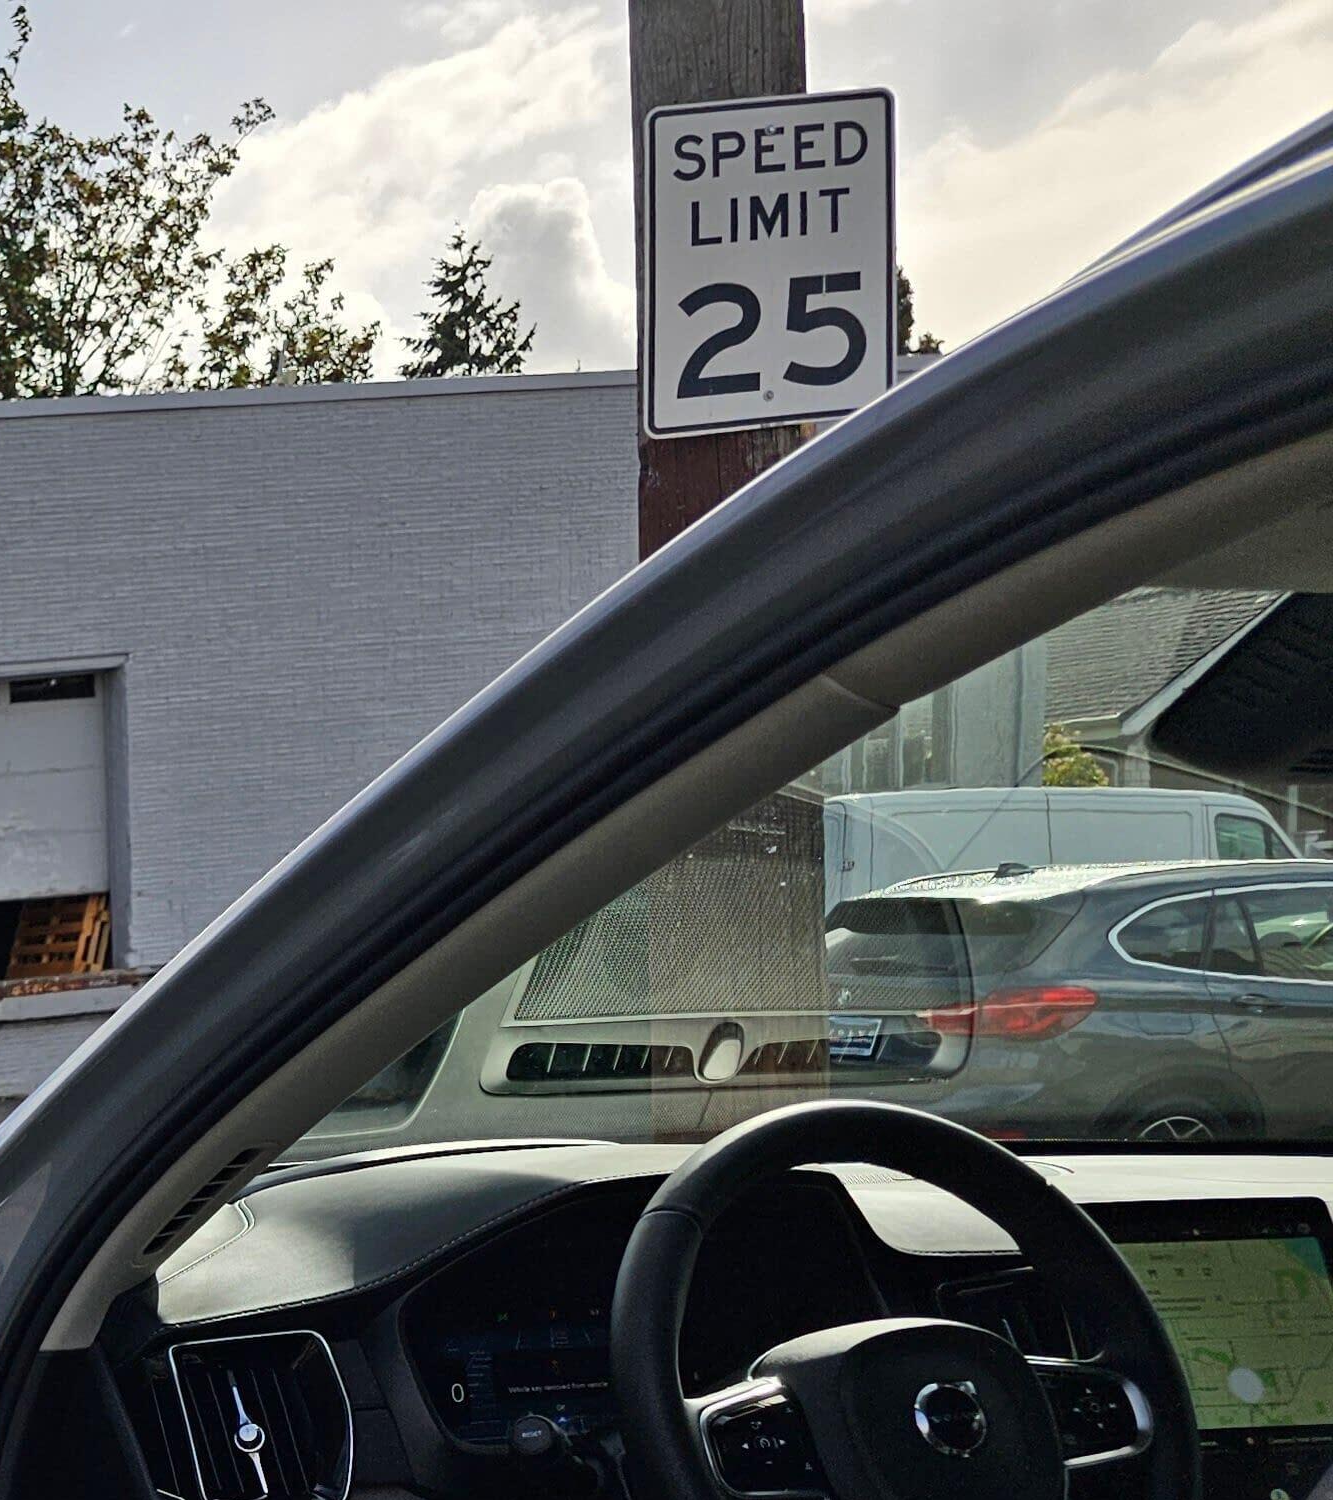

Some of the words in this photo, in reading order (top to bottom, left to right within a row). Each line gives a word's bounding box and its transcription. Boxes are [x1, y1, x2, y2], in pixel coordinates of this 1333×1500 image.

[673, 119, 869, 182] SPEED
[690, 187, 850, 247] LIMIT
[676, 271, 868, 400] 25
[451, 1383, 465, 1403] 0
